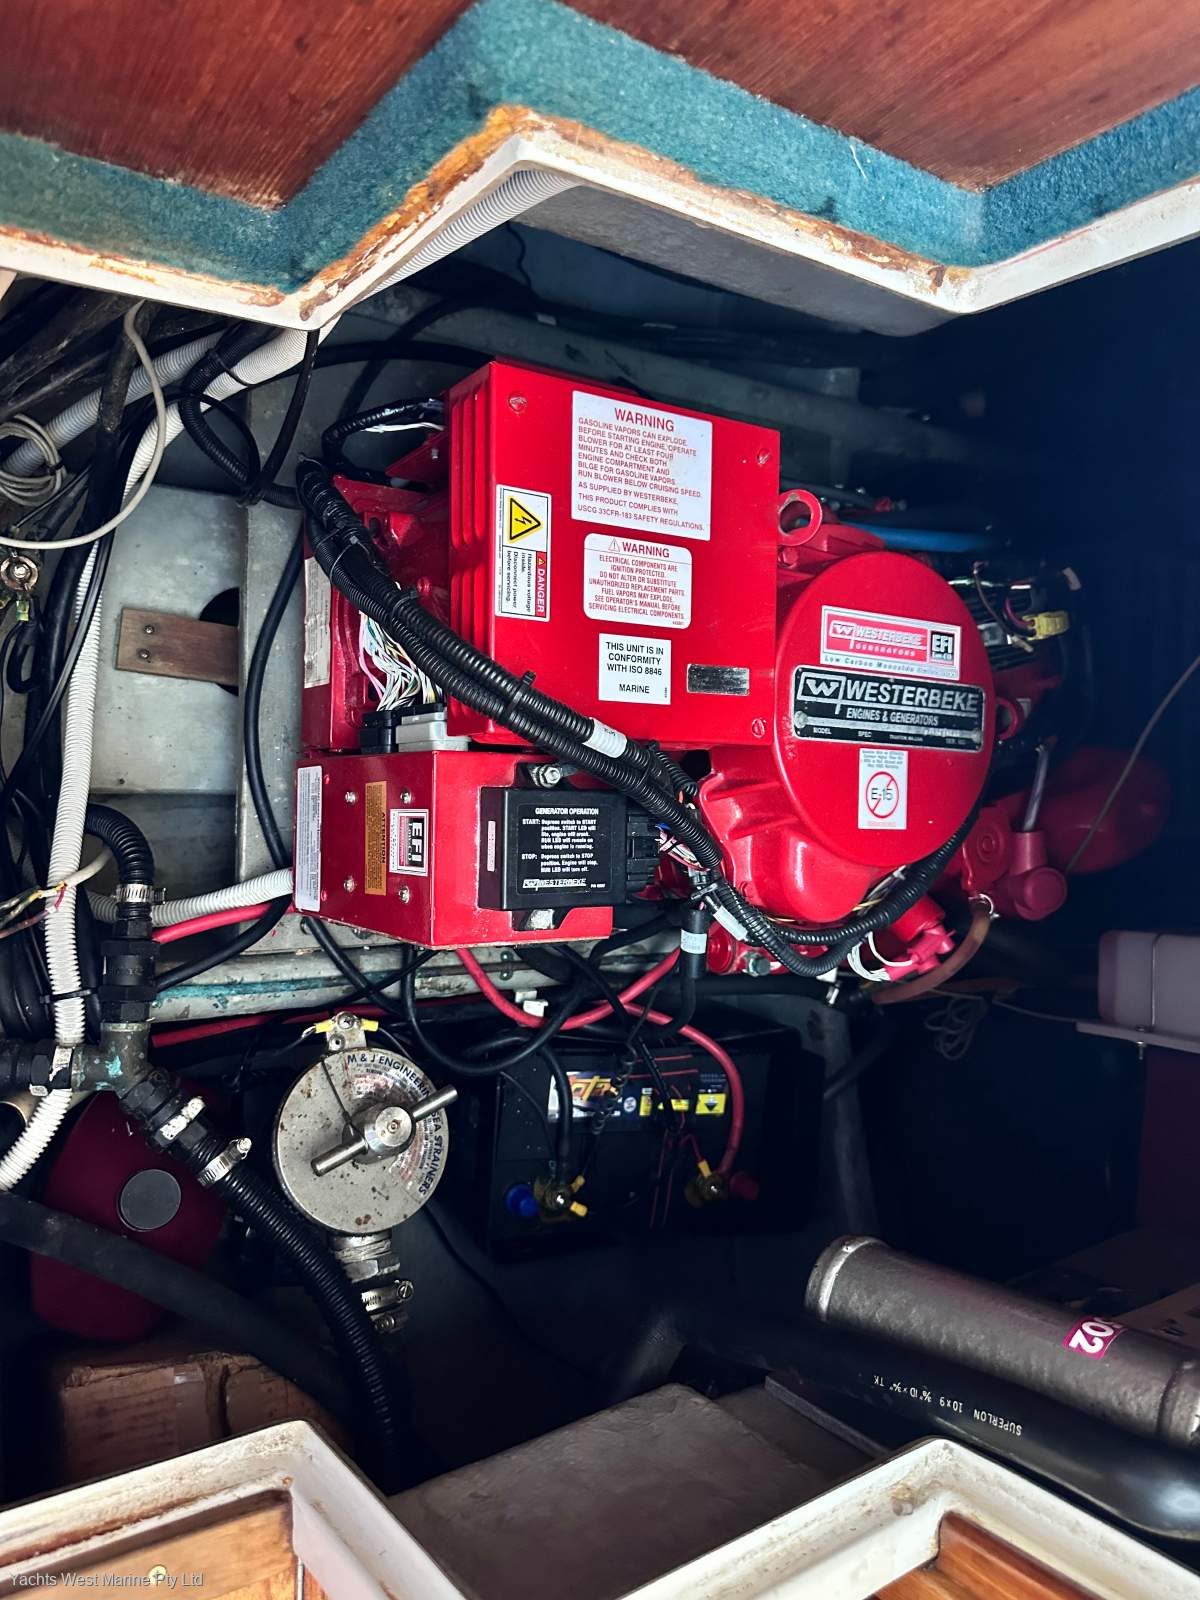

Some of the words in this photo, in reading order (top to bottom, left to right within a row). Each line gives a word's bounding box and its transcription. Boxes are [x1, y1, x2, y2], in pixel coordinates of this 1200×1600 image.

[578, 417, 613, 430] GASOLINE
[614, 424, 640, 436] VAPORS
[642, 430, 656, 440] CAN
[614, 408, 674, 432] WARNING
[578, 426, 606, 438] BEFORE
[608, 432, 640, 444] STARTING
[668, 444, 696, 456] OPERATE
[578, 434, 608, 446] BLOWER
[610, 440, 623, 450] FOR
[634, 446, 656, 456] LEAST
[656, 450, 674, 460] FOUR
[578, 444, 608, 455] MINUTES
[610, 450, 624, 458] AND
[625, 453, 648, 464] CHECK
[650, 458, 667, 466] BOTH
[578, 452, 604, 464] ENGINE
[605, 457, 655, 472] COMPARTMENT
[656, 467, 670, 476] AND
[578, 460, 598, 470] BILGE
[600, 465, 614, 474] FOR
[616, 468, 649, 480] GASOLINE
[578, 470, 592, 478] RUN
[594, 472, 622, 484] BLOWER
[624, 478, 648, 488] BELOW
[649, 482, 679, 494] CRUISING
[590, 483, 622, 494] SUPPLIED
[578, 492, 594, 502] THIS
[596, 495, 627, 507] PRODUCT
[629, 502, 661, 514] COMPLIES
[662, 507, 678, 516] WITH
[578, 504, 597, 514] USCG
[634, 514, 658, 524] SAFETY
[622, 541, 670, 558] WARNING
[600, 554, 630, 566] ELECTRICAL
[632, 560, 666, 570] COMPONENTS
[668, 564, 678, 572] ARE
[611, 564, 634, 574] IGNITION
[537, 568, 546, 612] DANGER
[589, 578, 630, 589] UNAUTHORIZED
[630, 583, 668, 594] REPLACEMENT
[620, 574, 636, 582] ALTER
[646, 577, 677, 588] SUBSTITUTE
[602, 587, 614, 596] FUEL
[616, 590, 636, 598] VAPORS
[588, 602, 616, 612] SERVICING
[618, 605, 648, 616] ELECTRICAL
[594, 594, 604, 602] SEE
[606, 596, 638, 606] OPERATOR'S
[640, 600, 660, 610] MANUAL
[662, 602, 680, 612] BEFORE
[856, 625, 923, 646] WESTERBEKE
[932, 634, 952, 653] EFI
[606, 641, 624, 652] THIS
[626, 644, 644, 653] UNIT
[646, 646, 654, 654] IS
[656, 647, 664, 655] IN
[856, 643, 916, 657] GENERATORS
[608, 652, 660, 666] CONFORMITY
[845, 658, 873, 668] Carbon
[877, 662, 915, 673] Monoxide
[607, 663, 627, 672] WITH
[630, 665, 642, 674] ISO
[645, 666, 662, 676] 8846
[619, 684, 650, 694] MARINE
[846, 679, 979, 712] WESTERBEKE
[846, 708, 880, 721] ENGINES
[882, 710, 888, 722] &
[890, 711, 939, 726] GENERATORS
[813, 727, 832, 735] MODEL
[871, 788, 894, 800] E-15
[412, 822, 422, 862] EFI
[347, 1054, 356, 1065] M
[360, 1054, 366, 1062] &
[371, 1054, 376, 1062] J
[379, 1056, 430, 1097] ENGINEERIN
[432, 1111, 441, 1132] SEA
[418, 1136, 443, 1195] STRAINERS
[874, 1375, 884, 1386] TK
[974, 1408, 1022, 1436] SUPERLON
